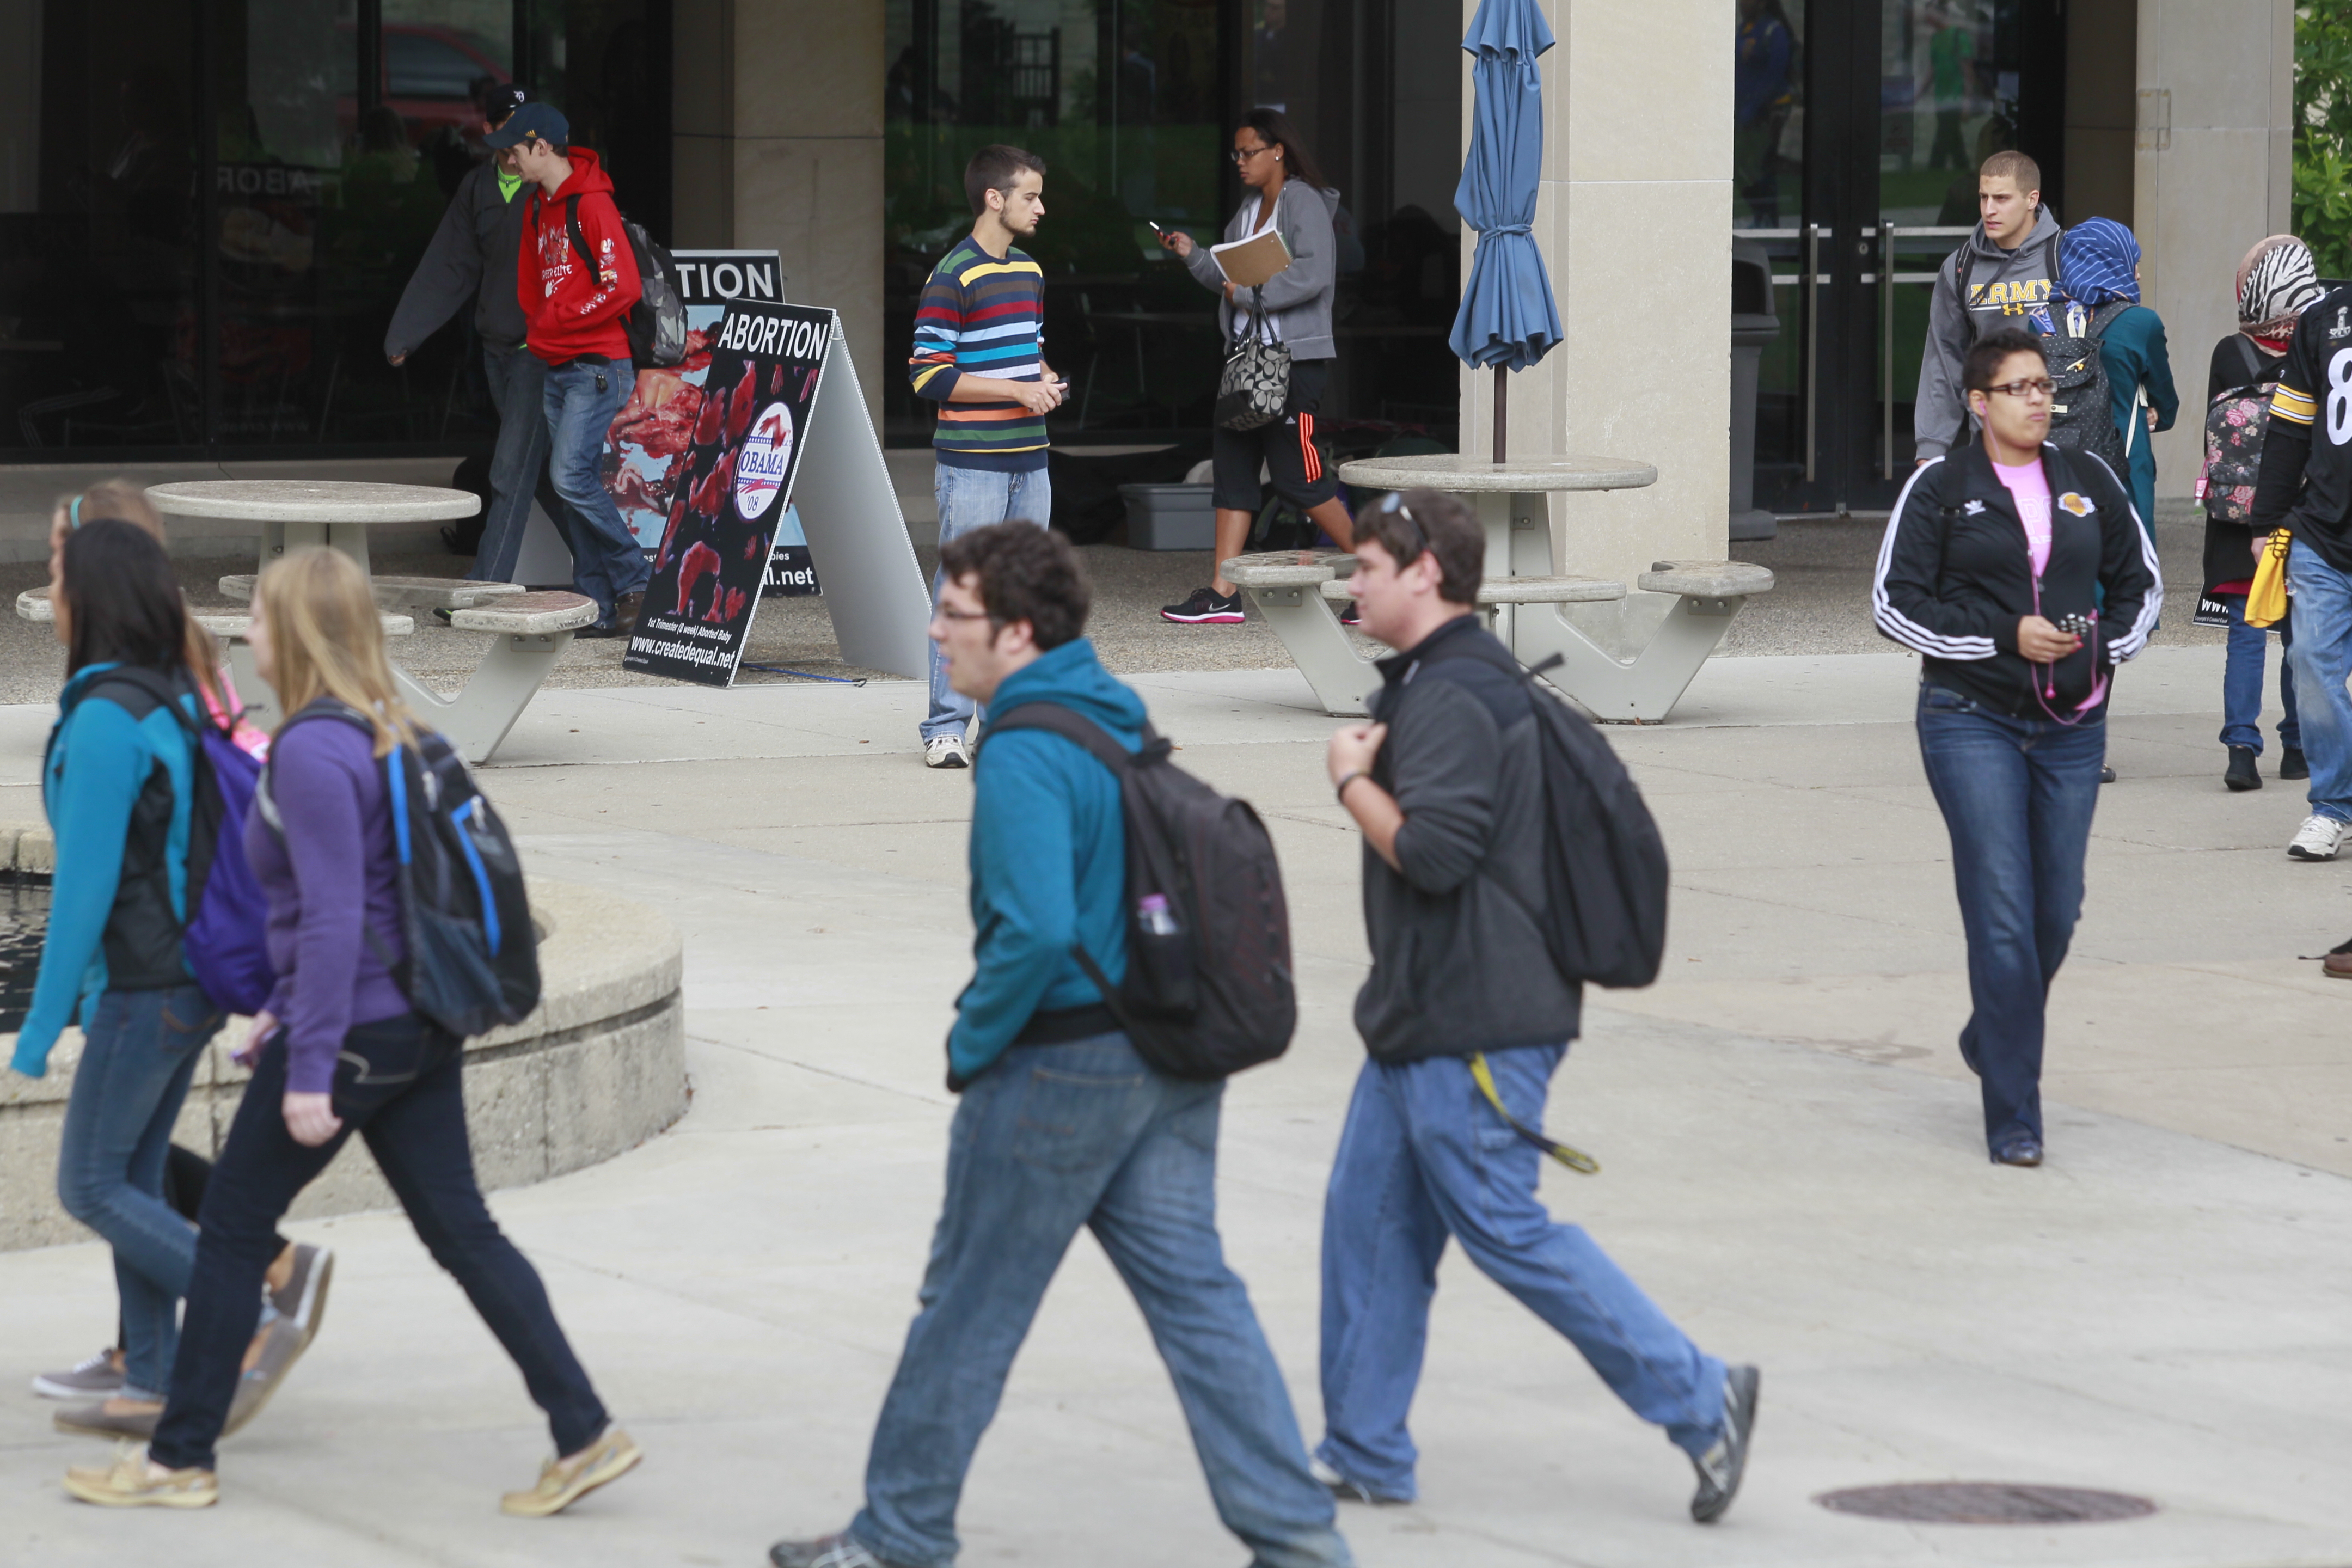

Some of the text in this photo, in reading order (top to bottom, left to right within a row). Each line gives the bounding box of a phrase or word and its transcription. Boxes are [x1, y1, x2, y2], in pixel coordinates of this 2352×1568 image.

[1969, 279, 2053, 305] ARMY
[718, 313, 828, 360] ABORTION
[740, 451, 784, 475] OBAMA
[747, 495, 759, 511] '08
[647, 617, 656, 628] 1st
[656, 618, 678, 632] Trimester
[683, 625, 699, 638] week)
[697, 627, 718, 639] Aborted
[717, 630, 732, 644] Baby
[630, 636, 736, 669] www.createdequal.net
